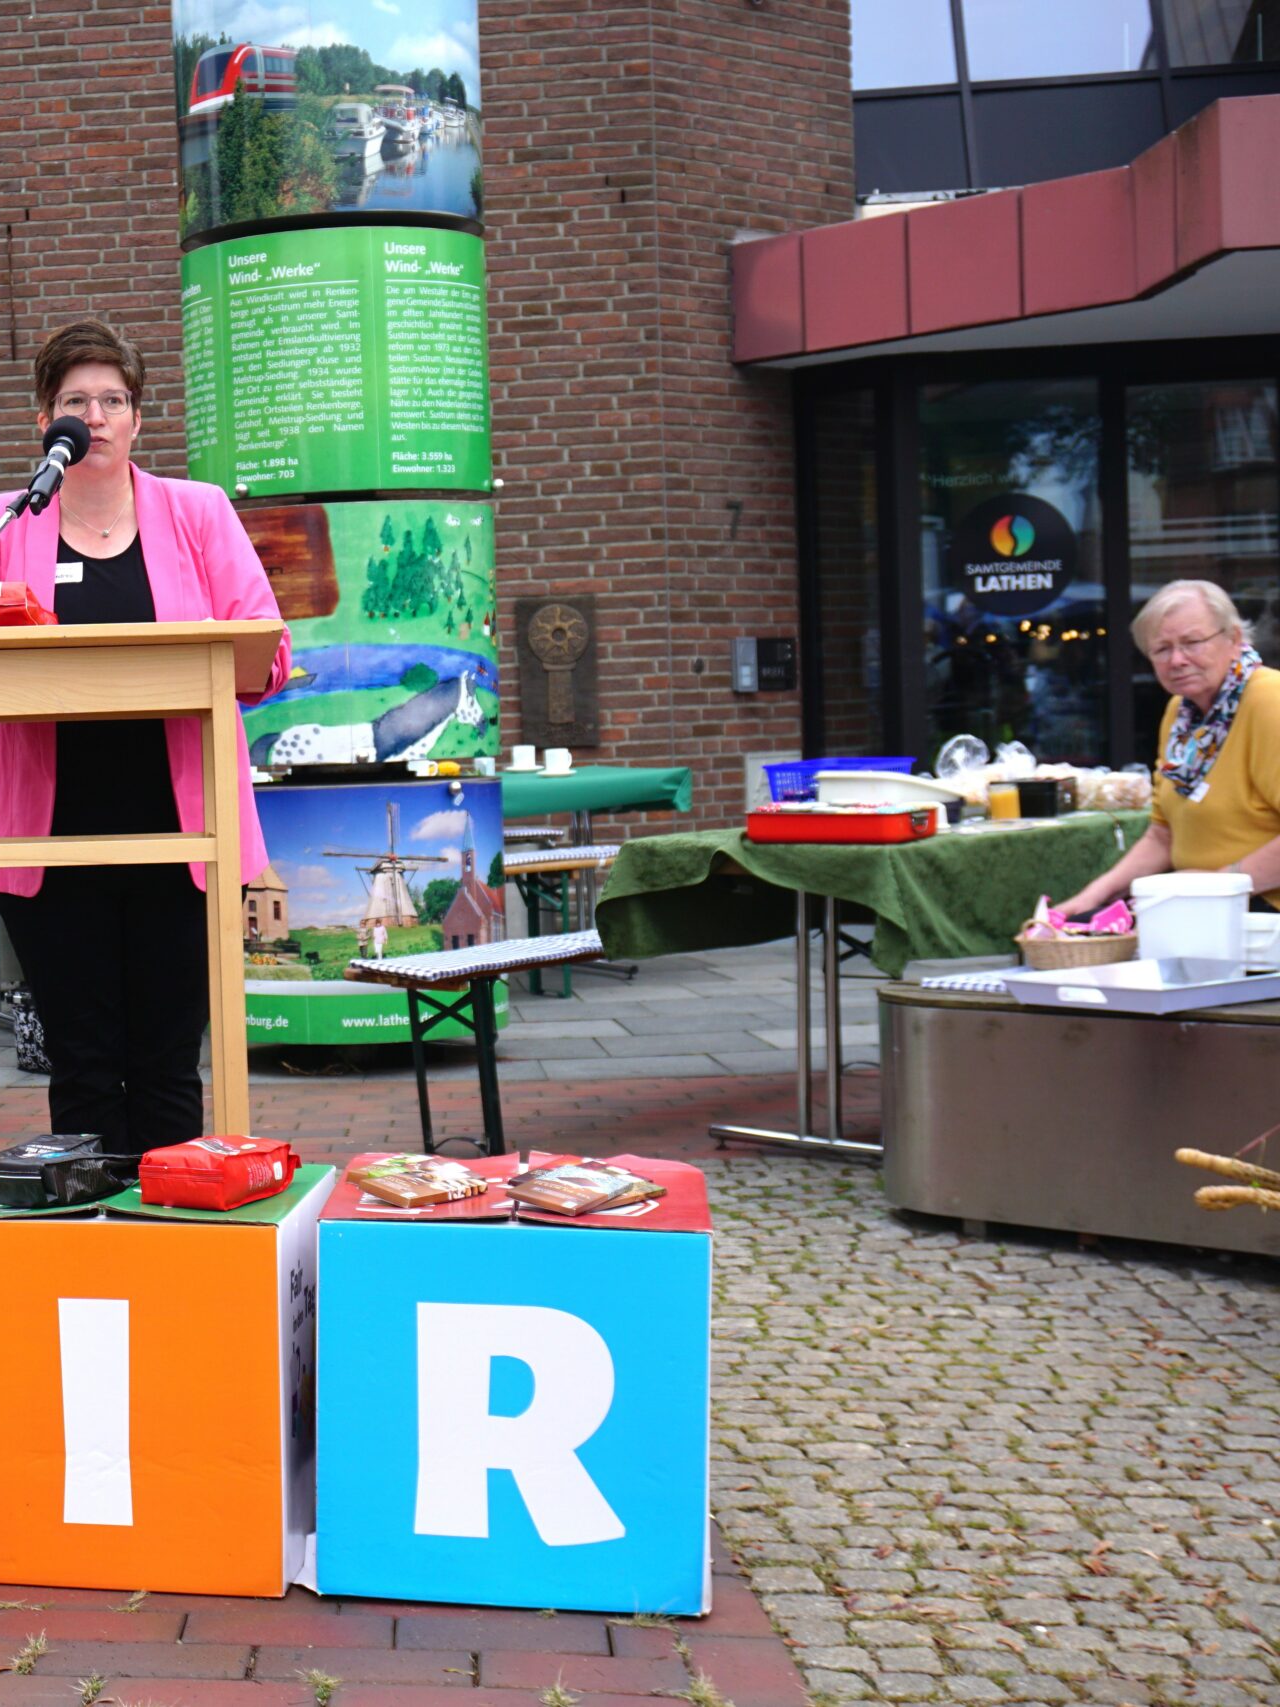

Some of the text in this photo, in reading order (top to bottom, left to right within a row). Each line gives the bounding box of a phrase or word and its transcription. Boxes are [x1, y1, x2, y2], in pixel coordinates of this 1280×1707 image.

[384, 242, 426, 255] Unsere
[229, 253, 267, 268] Unsere
[385, 259, 422, 273] Wind-
[229, 268, 262, 285] Wind-
[340, 343, 360, 352] 1932
[334, 423, 364, 432] Namen
[288, 456, 298, 466] ha
[236, 470, 295, 483] Einwohner: 703
[966, 559, 1063, 575] SAMTGEMEINDE
[974, 574, 1053, 593] LATHEN
